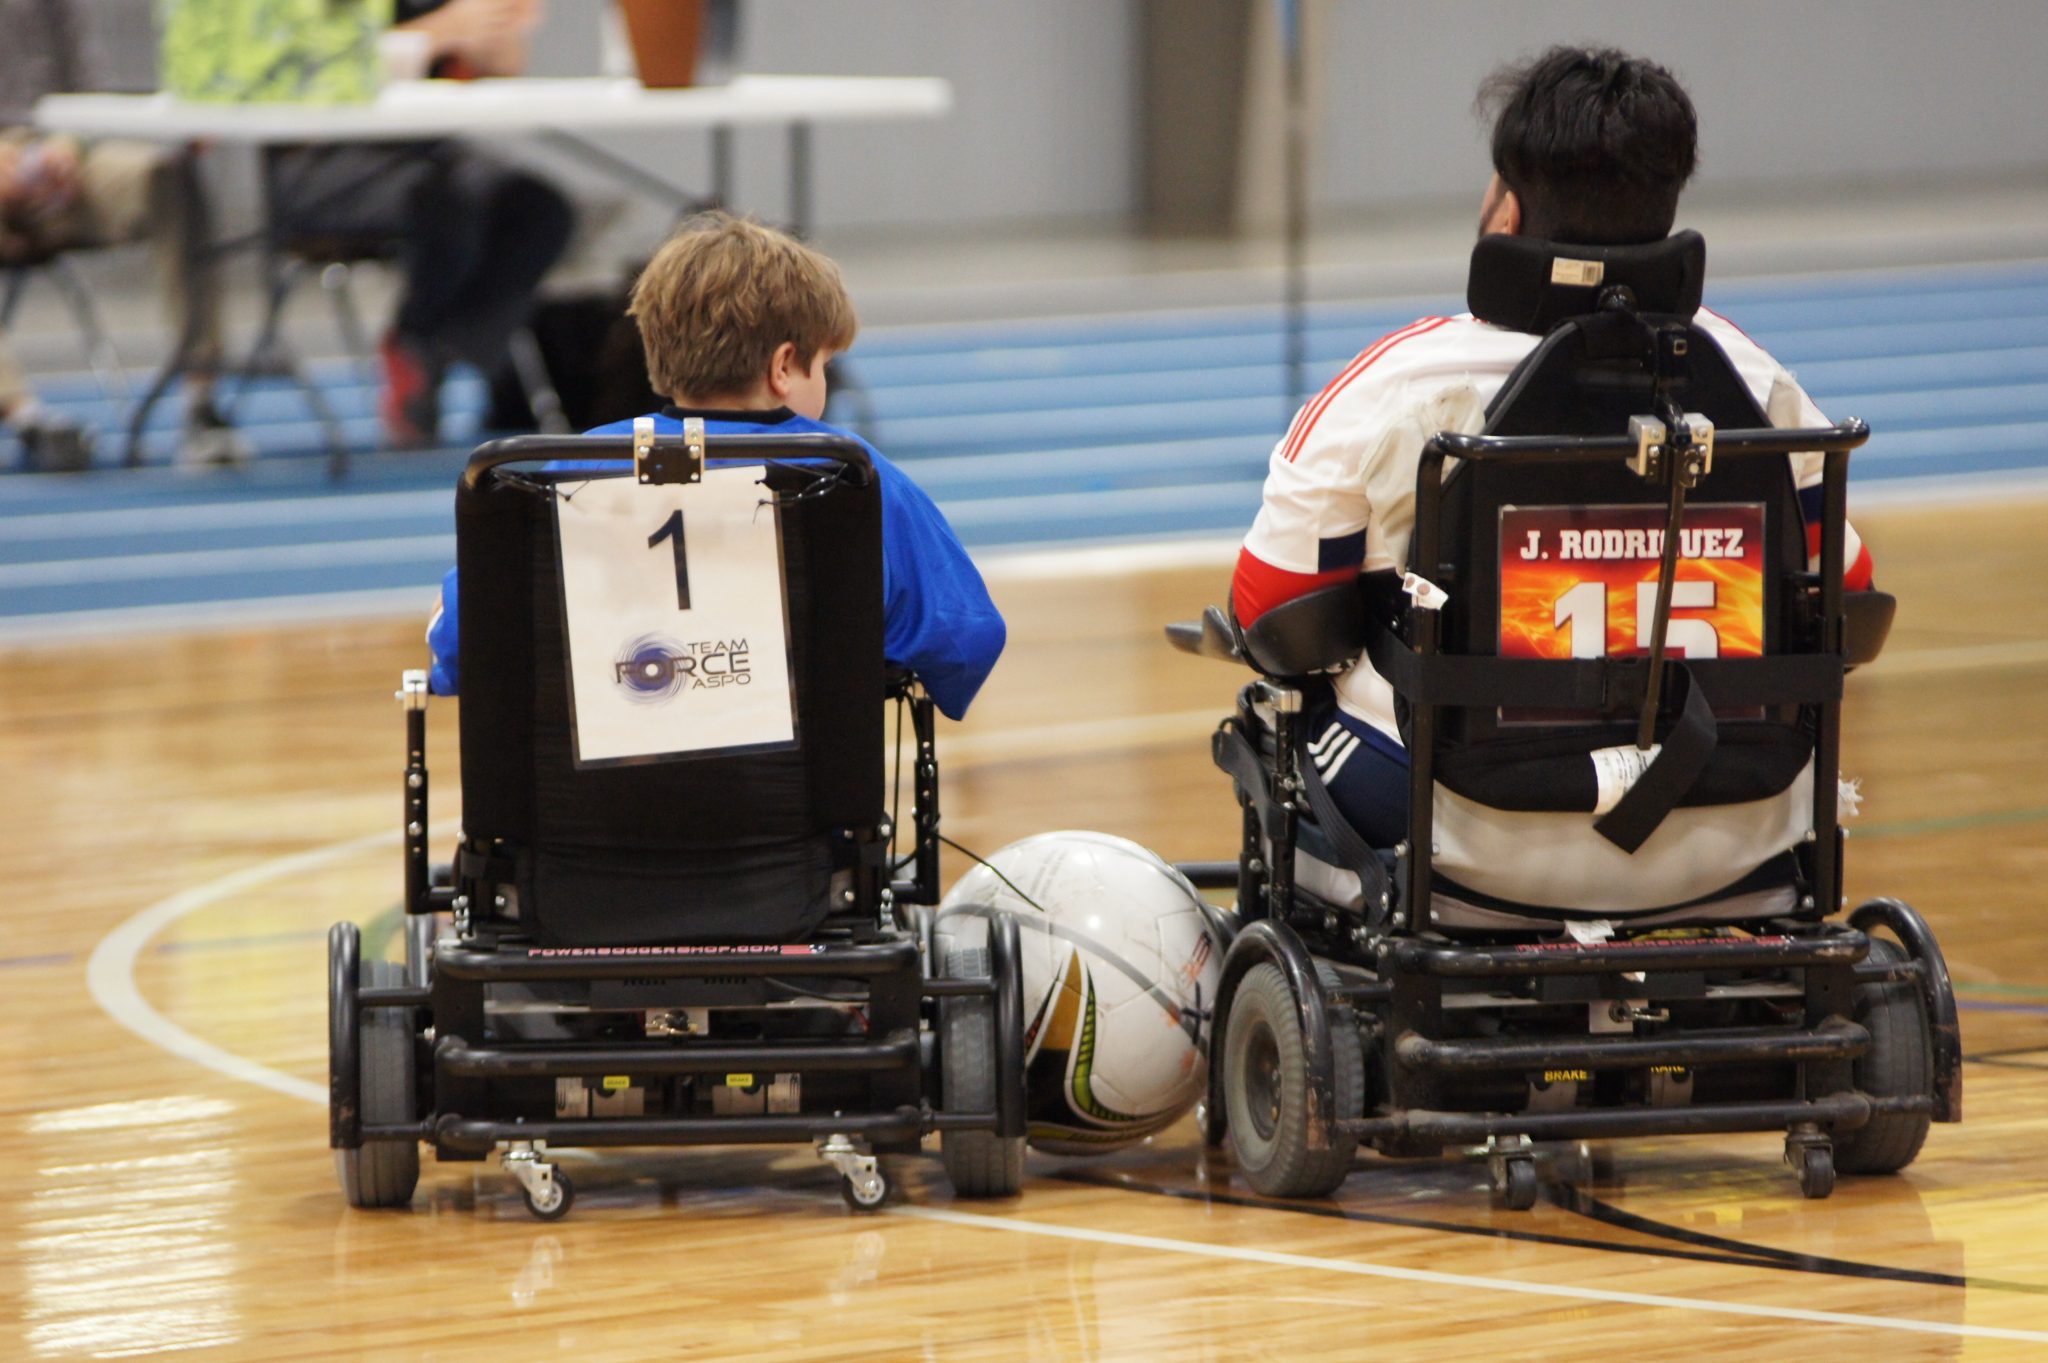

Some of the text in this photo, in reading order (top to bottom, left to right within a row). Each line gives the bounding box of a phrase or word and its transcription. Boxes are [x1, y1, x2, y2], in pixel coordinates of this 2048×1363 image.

[648, 509, 691, 610] 1
[1520, 530, 1548, 560] J.
[1554, 580, 1719, 659] 15
[687, 637, 749, 655] TEAM
[615, 651, 751, 684] FORCE
[691, 674, 751, 690] ASPO
[1544, 1069, 1588, 1083] BRAKE
